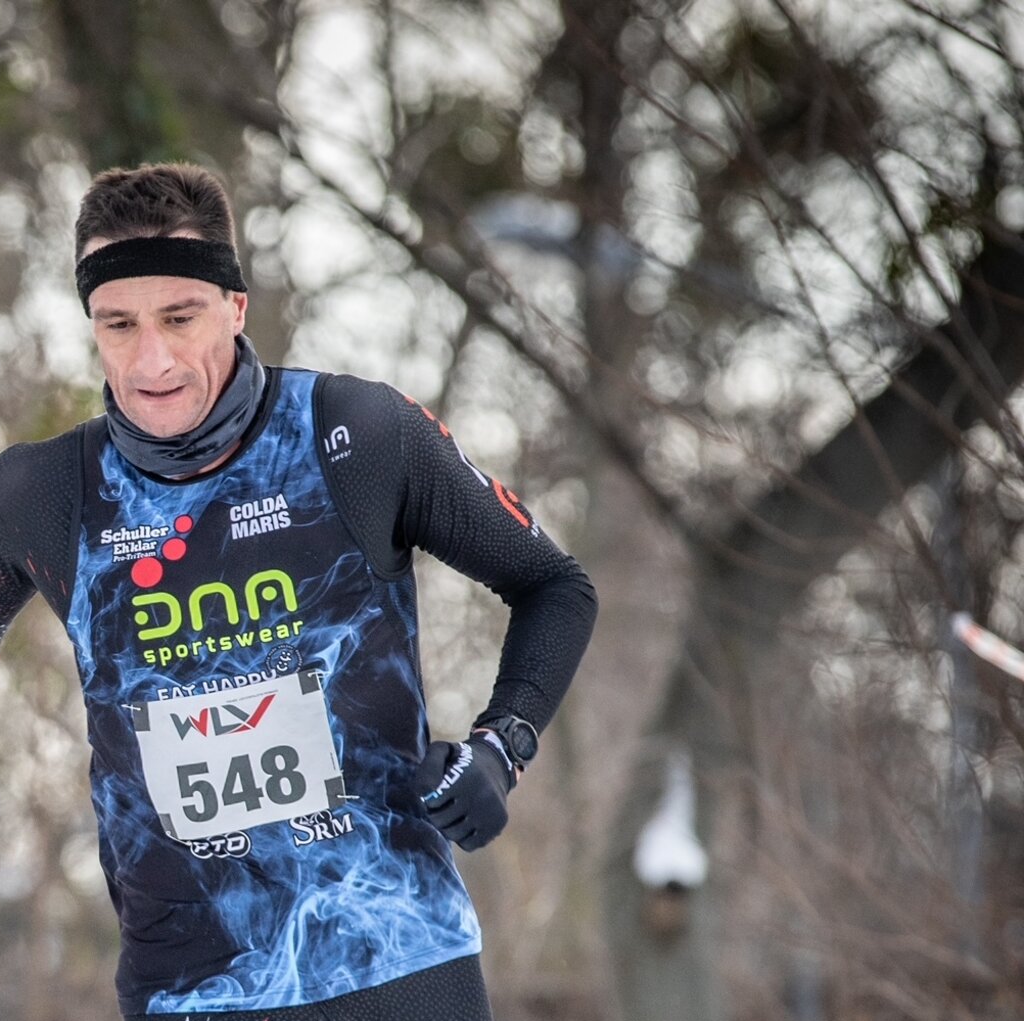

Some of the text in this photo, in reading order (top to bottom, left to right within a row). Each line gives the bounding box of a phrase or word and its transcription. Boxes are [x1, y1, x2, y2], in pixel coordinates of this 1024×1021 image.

[229, 493, 289, 522] COLDA
[231, 510, 292, 540] MARIS
[100, 525, 170, 544] Schuller
[131, 569, 298, 641] DNA
[142, 619, 304, 667] sportswear
[156, 683, 196, 701] EAT
[169, 693, 277, 741] WLV
[175, 744, 308, 823] 548
[288, 812, 355, 848] SRM
